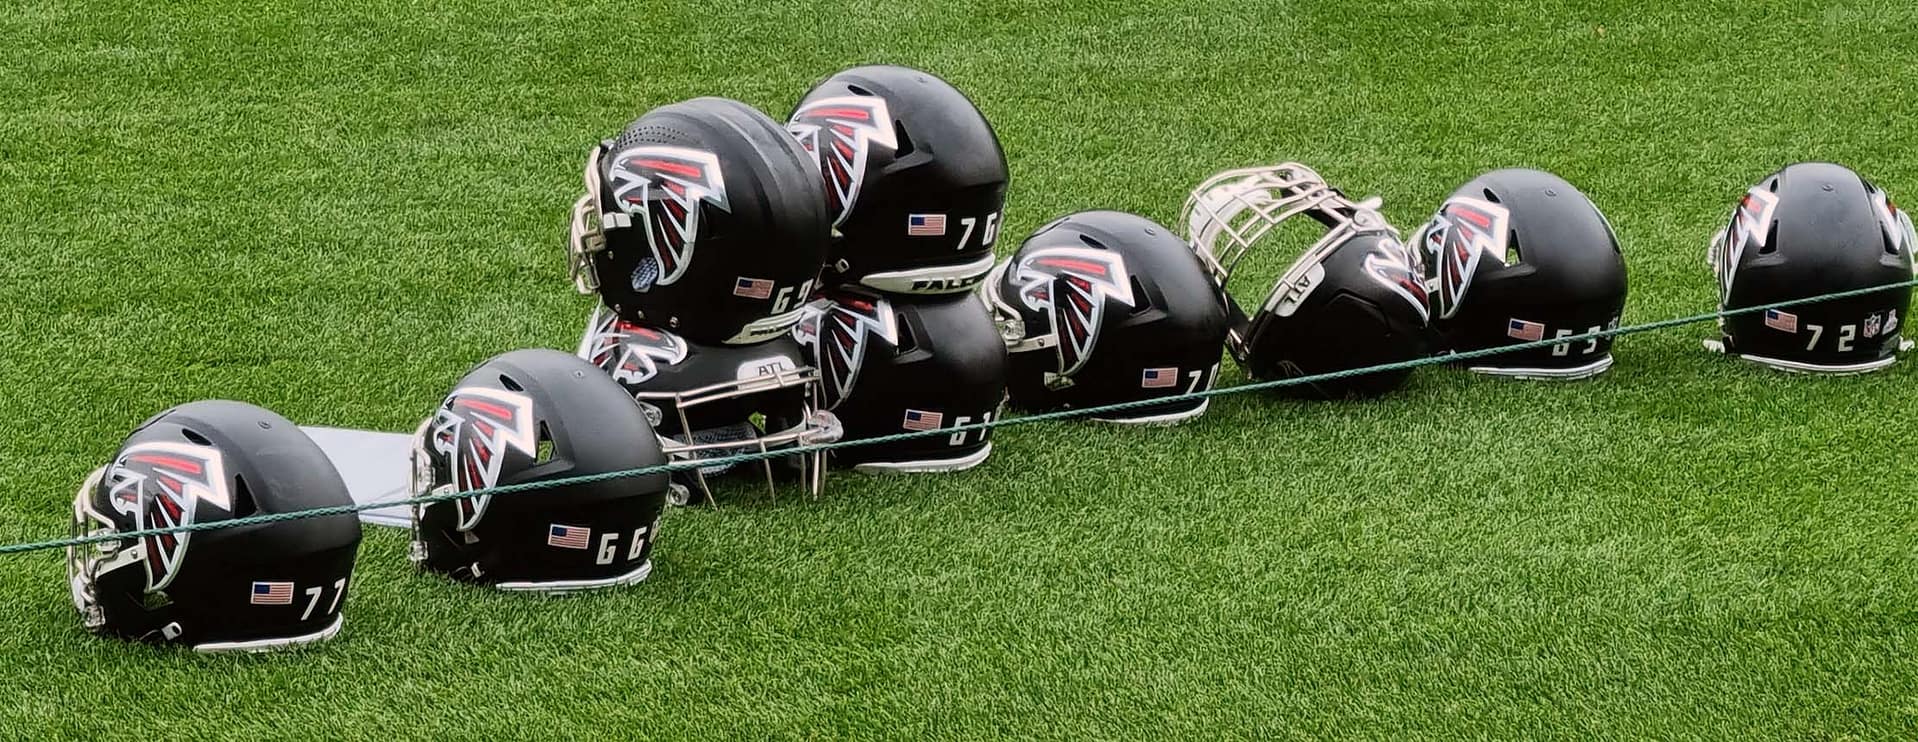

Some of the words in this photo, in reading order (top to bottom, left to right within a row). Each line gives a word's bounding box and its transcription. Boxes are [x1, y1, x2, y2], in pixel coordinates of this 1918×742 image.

[957, 212, 998, 250] 76
[770, 278, 814, 315] 69
[1284, 275, 1311, 304] ATL
[1806, 324, 1857, 352] 72
[949, 411, 991, 446] 61
[596, 526, 648, 565] 66
[300, 577, 346, 621] 77
